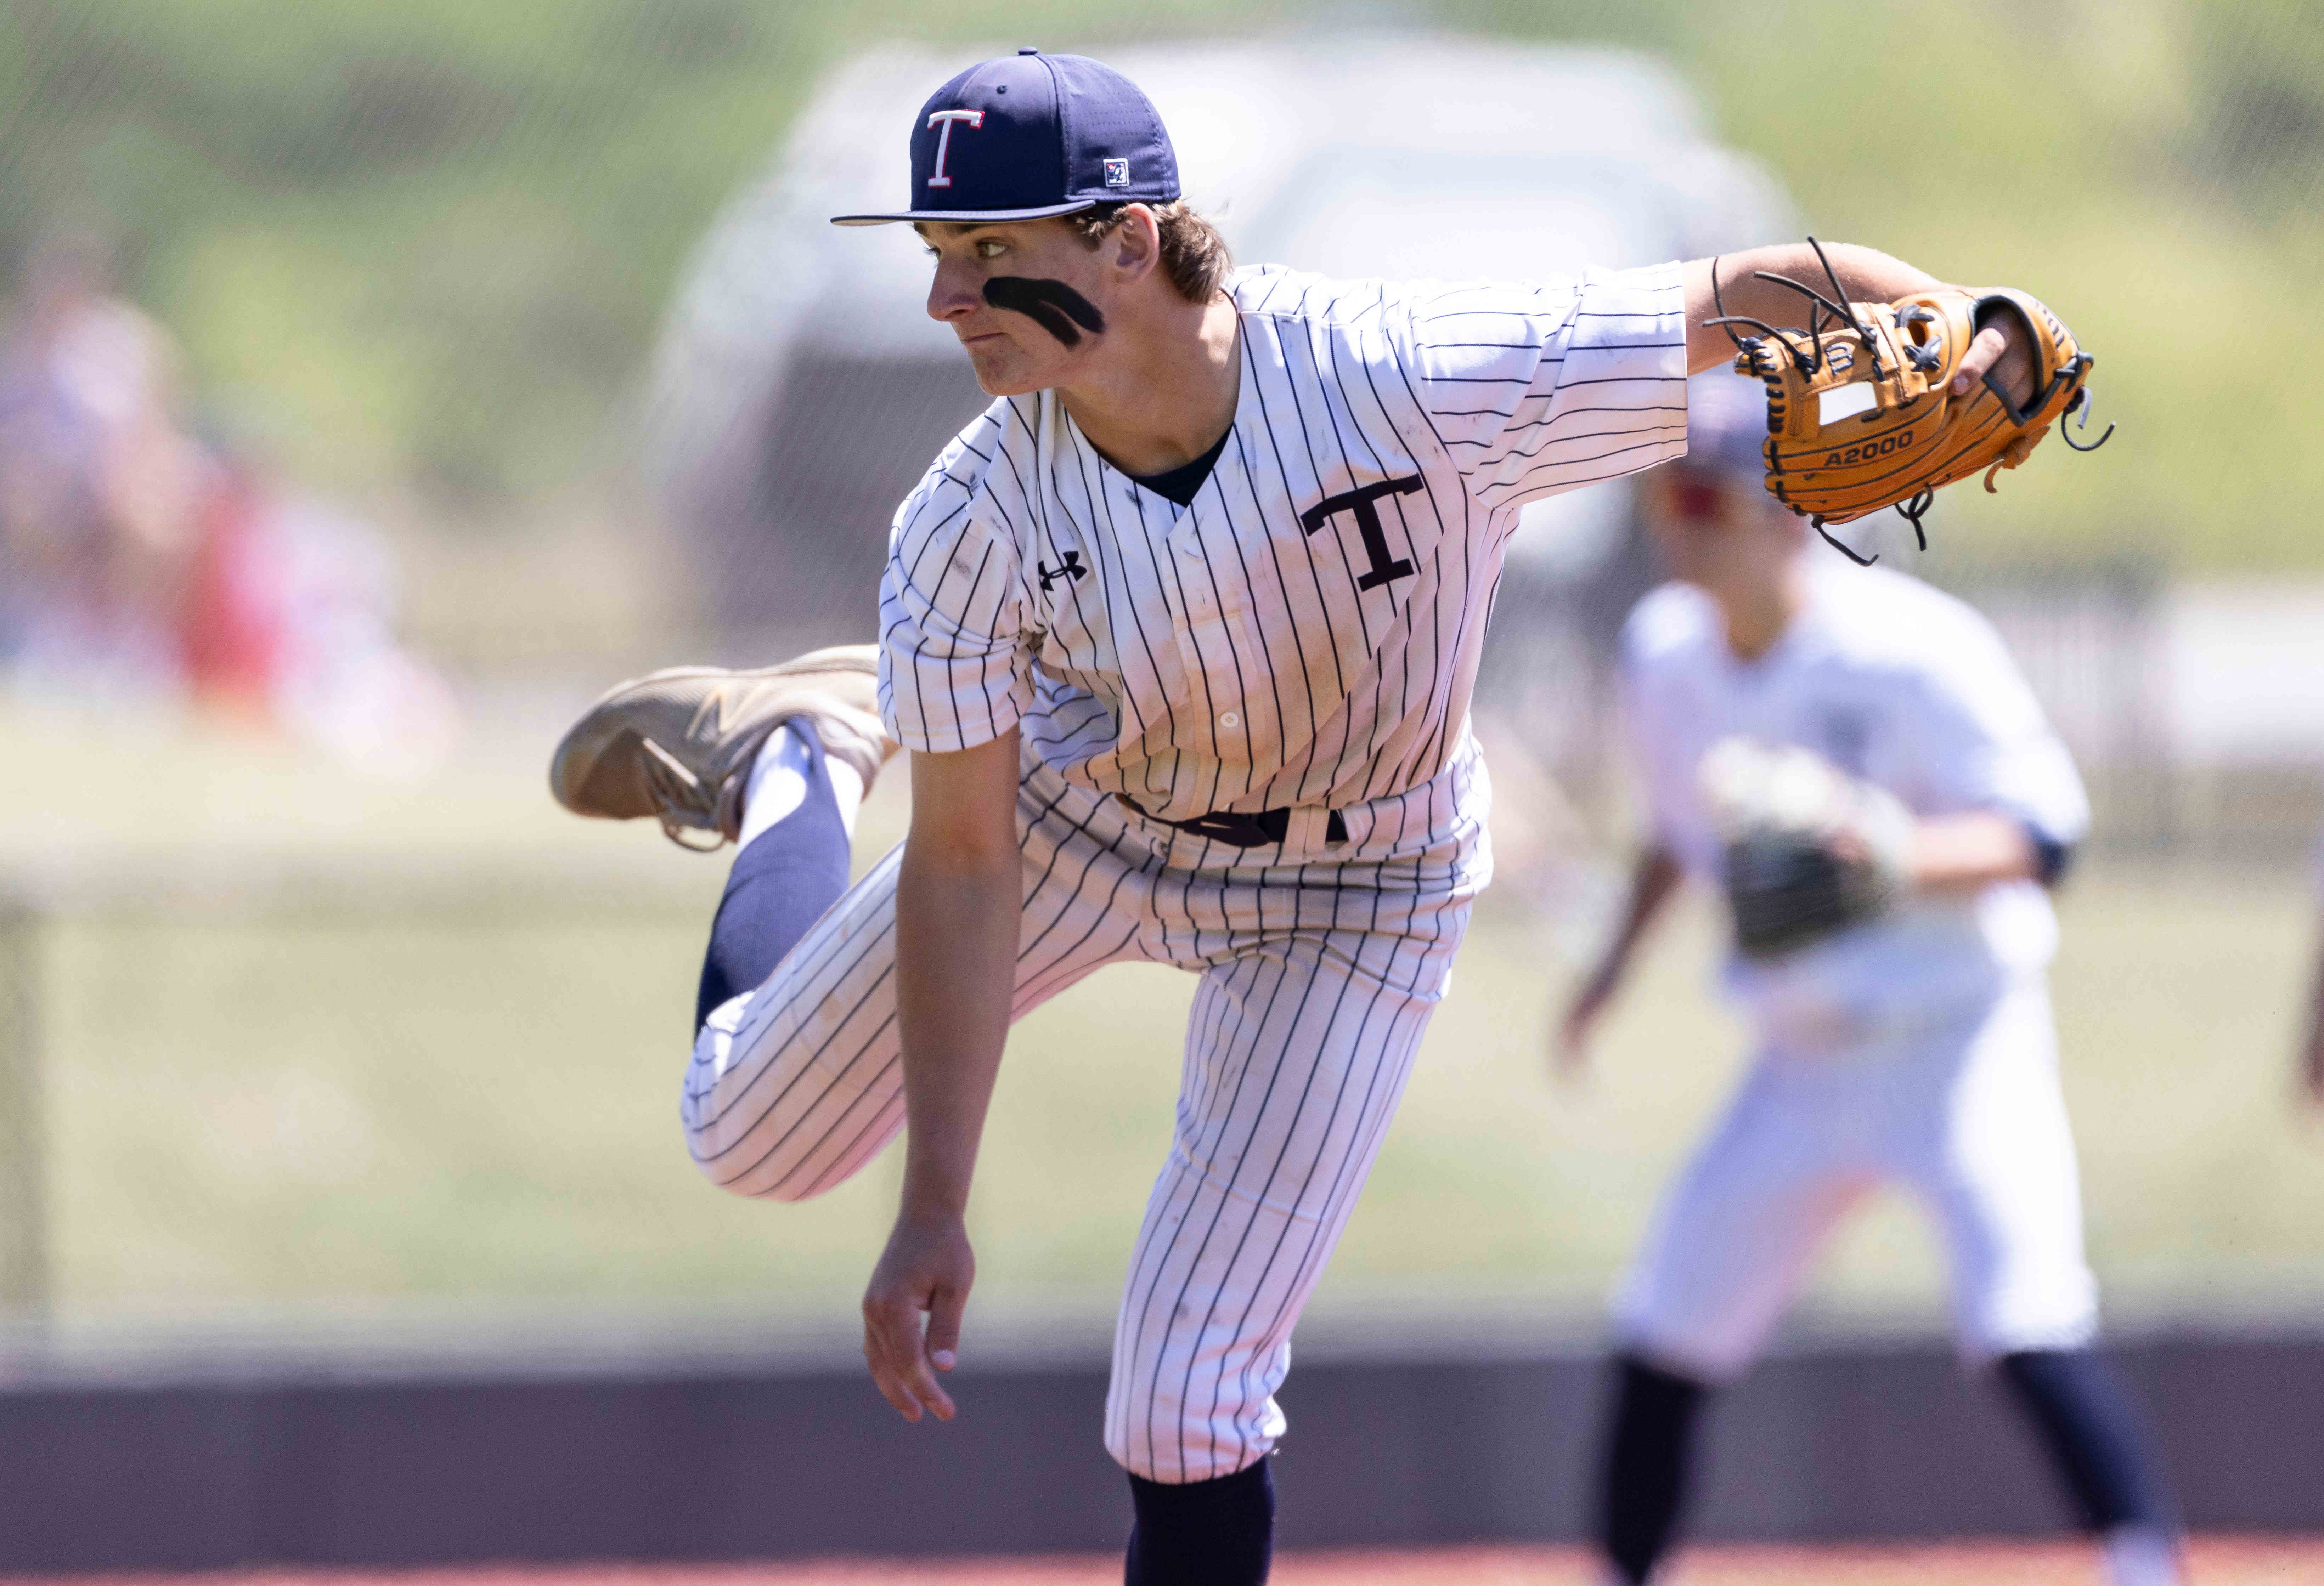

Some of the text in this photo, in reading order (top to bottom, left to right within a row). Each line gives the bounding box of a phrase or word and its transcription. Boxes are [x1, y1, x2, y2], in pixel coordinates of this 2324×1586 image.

[927, 109, 985, 189] T
[1824, 430, 1913, 466] A2000
[1300, 473, 1424, 592] T
